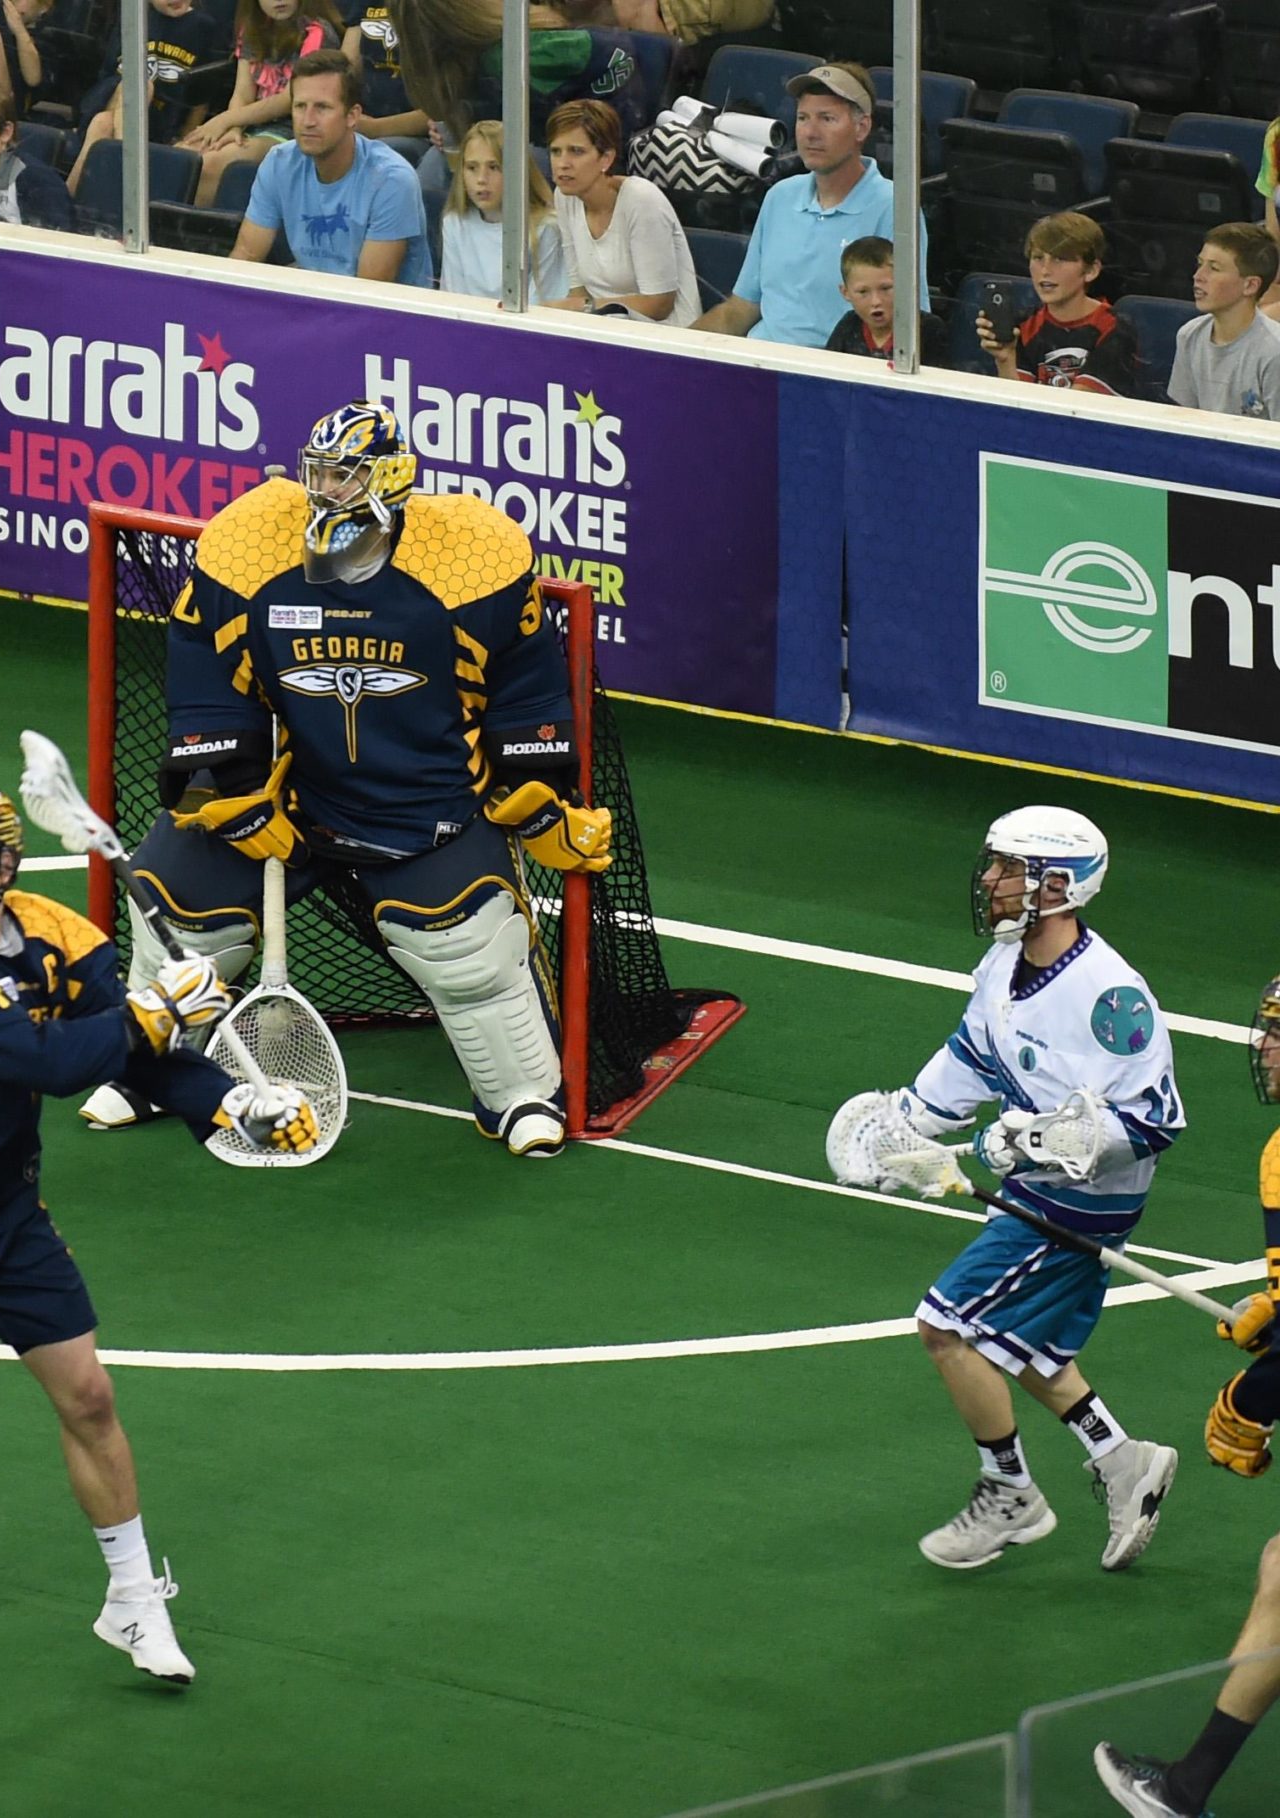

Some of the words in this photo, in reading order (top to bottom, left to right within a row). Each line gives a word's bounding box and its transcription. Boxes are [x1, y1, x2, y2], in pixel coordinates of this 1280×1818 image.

[535, 553, 626, 606] IVER
[292, 636, 405, 664] GEORGIA
[171, 738, 239, 758] BODDAM
[502, 741, 570, 756] BODDAM
